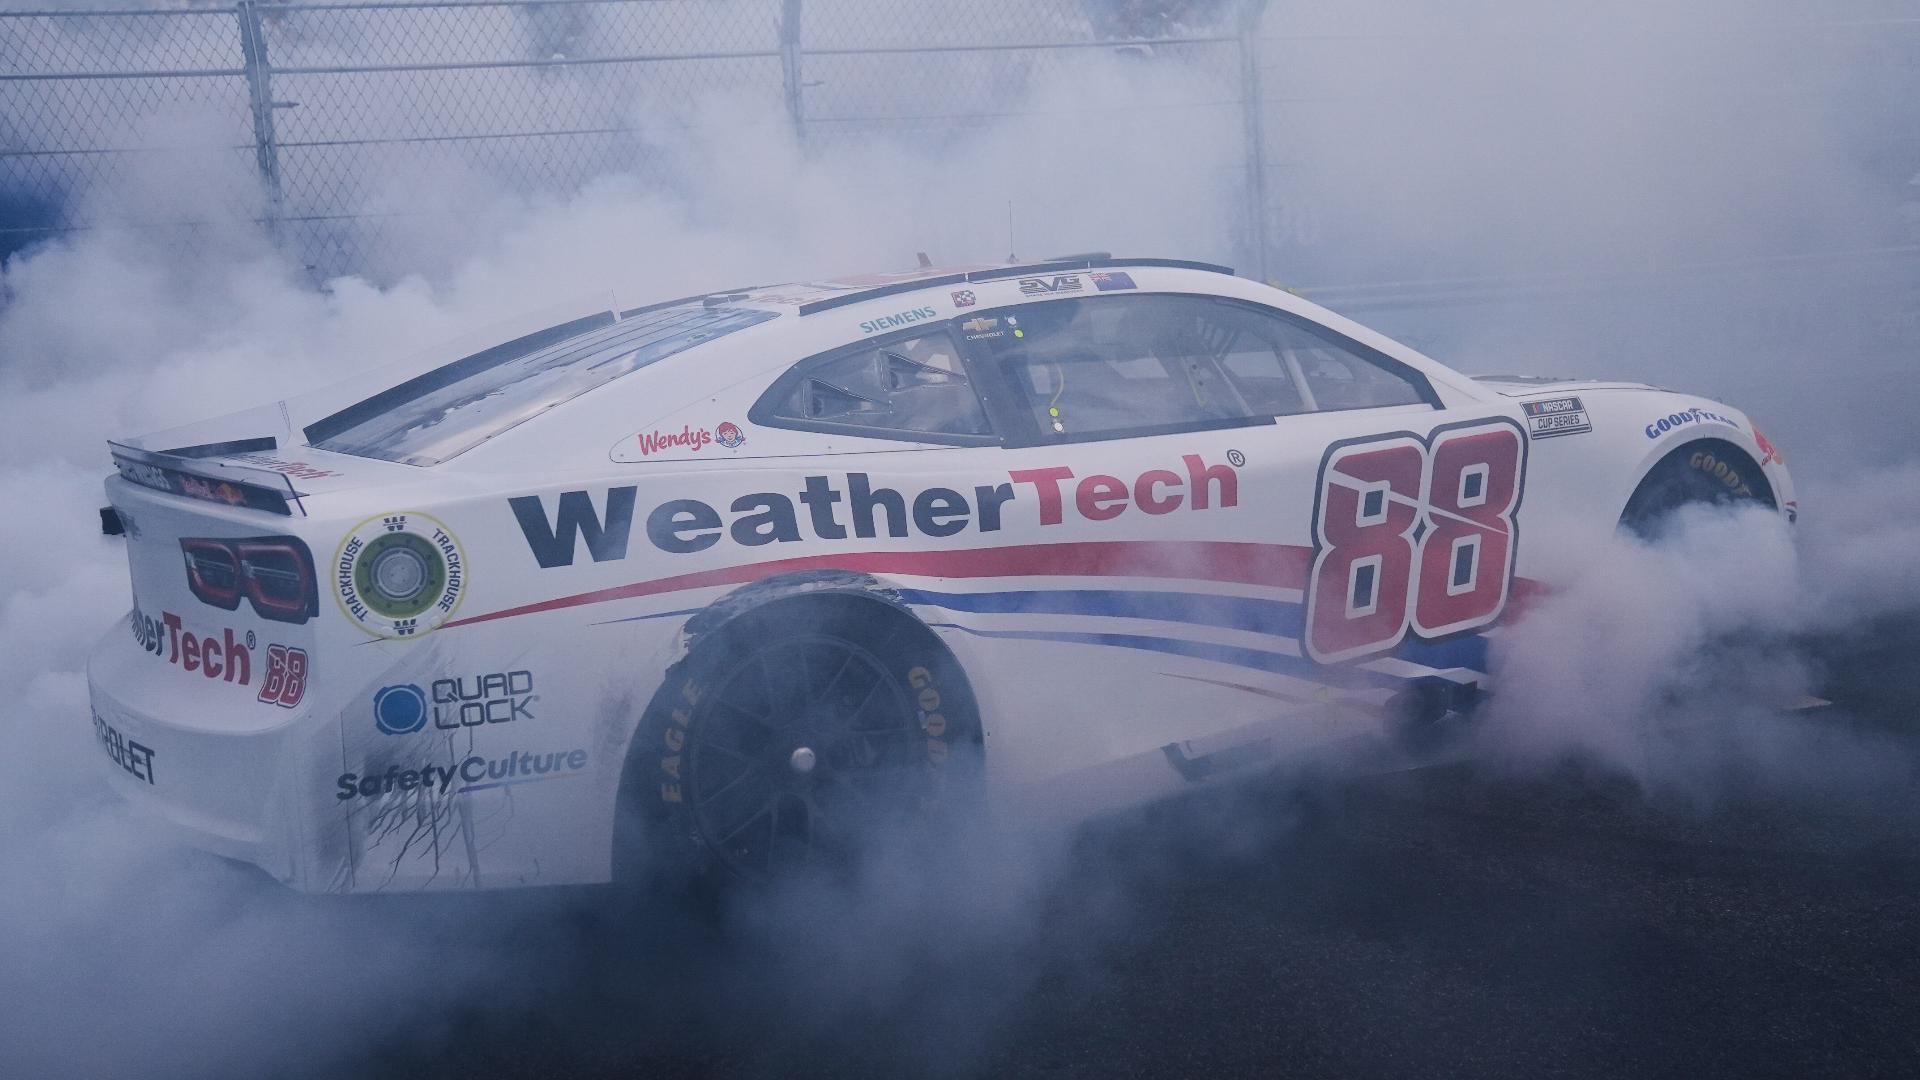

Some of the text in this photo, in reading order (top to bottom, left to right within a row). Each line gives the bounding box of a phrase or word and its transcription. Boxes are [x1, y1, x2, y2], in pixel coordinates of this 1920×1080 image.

[860, 306, 936, 334] SIEMENS
[1538, 415, 1580, 429] CUP SERIES
[1543, 400, 1573, 413] NASCAR
[638, 425, 712, 456] Wendy's
[1689, 451, 1752, 496] GOODY
[1302, 415, 1528, 665] 88
[339, 536, 369, 622] TRACKHOUSE
[432, 528, 461, 613] TRACKHOUSE
[258, 643, 309, 709] 88
[432, 670, 534, 704] QUAD
[433, 695, 535, 730] LOCK
[660, 678, 702, 803] EAGLE
[336, 749, 589, 801] SafetyCulture
